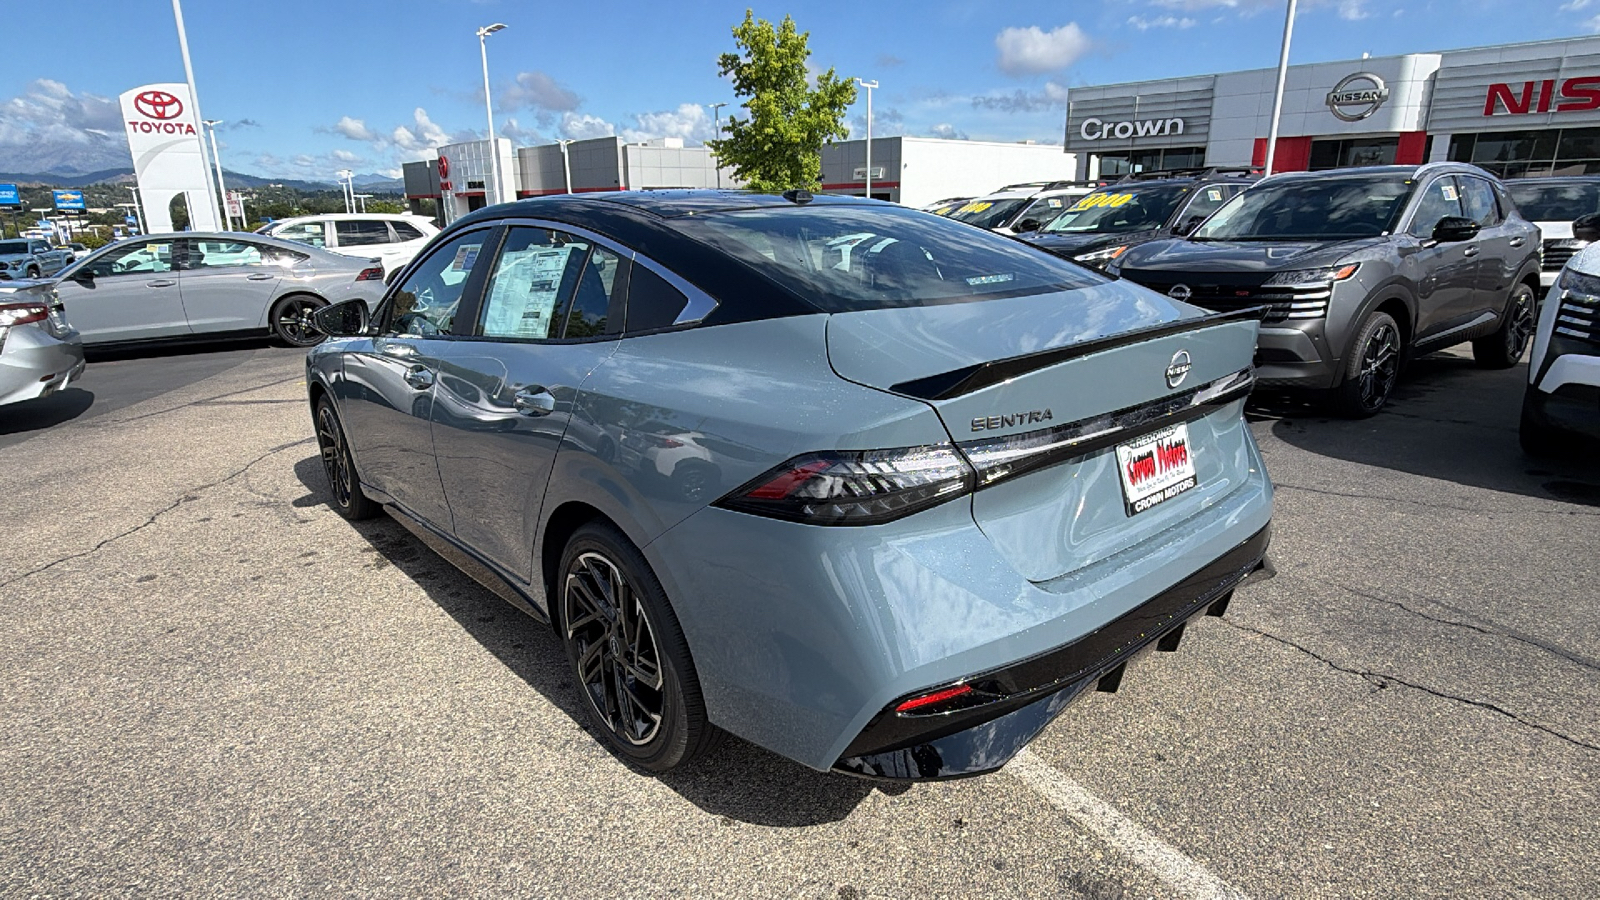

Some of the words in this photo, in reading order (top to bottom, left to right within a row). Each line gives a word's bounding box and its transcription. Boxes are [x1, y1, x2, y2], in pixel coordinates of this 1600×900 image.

[1331, 91, 1383, 103] NISSAN
[128, 121, 197, 136] TOYOTA
[1080, 117, 1185, 141] Crown
[1166, 363, 1192, 377] NISSAN
[970, 407, 1054, 432] SENTRA
[1126, 449, 1157, 487] Crown
[1156, 437, 1188, 476] Motors
[1134, 490, 1165, 513] CROWN
[1164, 477, 1195, 500] MOTORS
